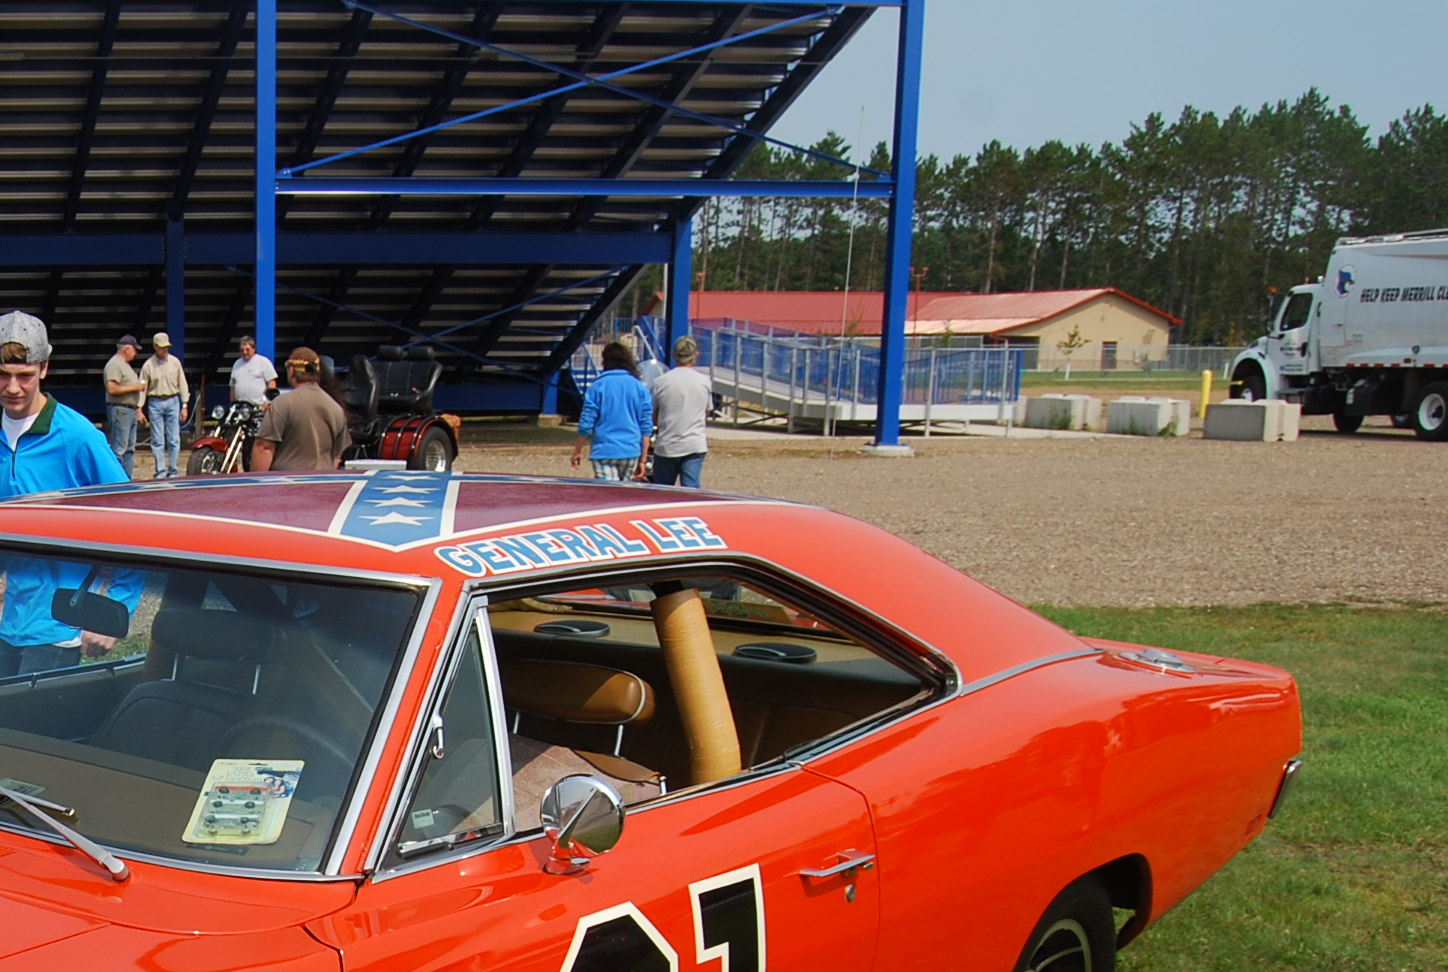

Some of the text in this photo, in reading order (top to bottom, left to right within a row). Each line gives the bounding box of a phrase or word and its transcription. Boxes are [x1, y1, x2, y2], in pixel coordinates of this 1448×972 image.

[1360, 288, 1380, 303] HELP
[1380, 287, 1401, 303] KEEP
[1400, 286, 1436, 302] MERRILL
[434, 516, 728, 578] GENERAL LEE
